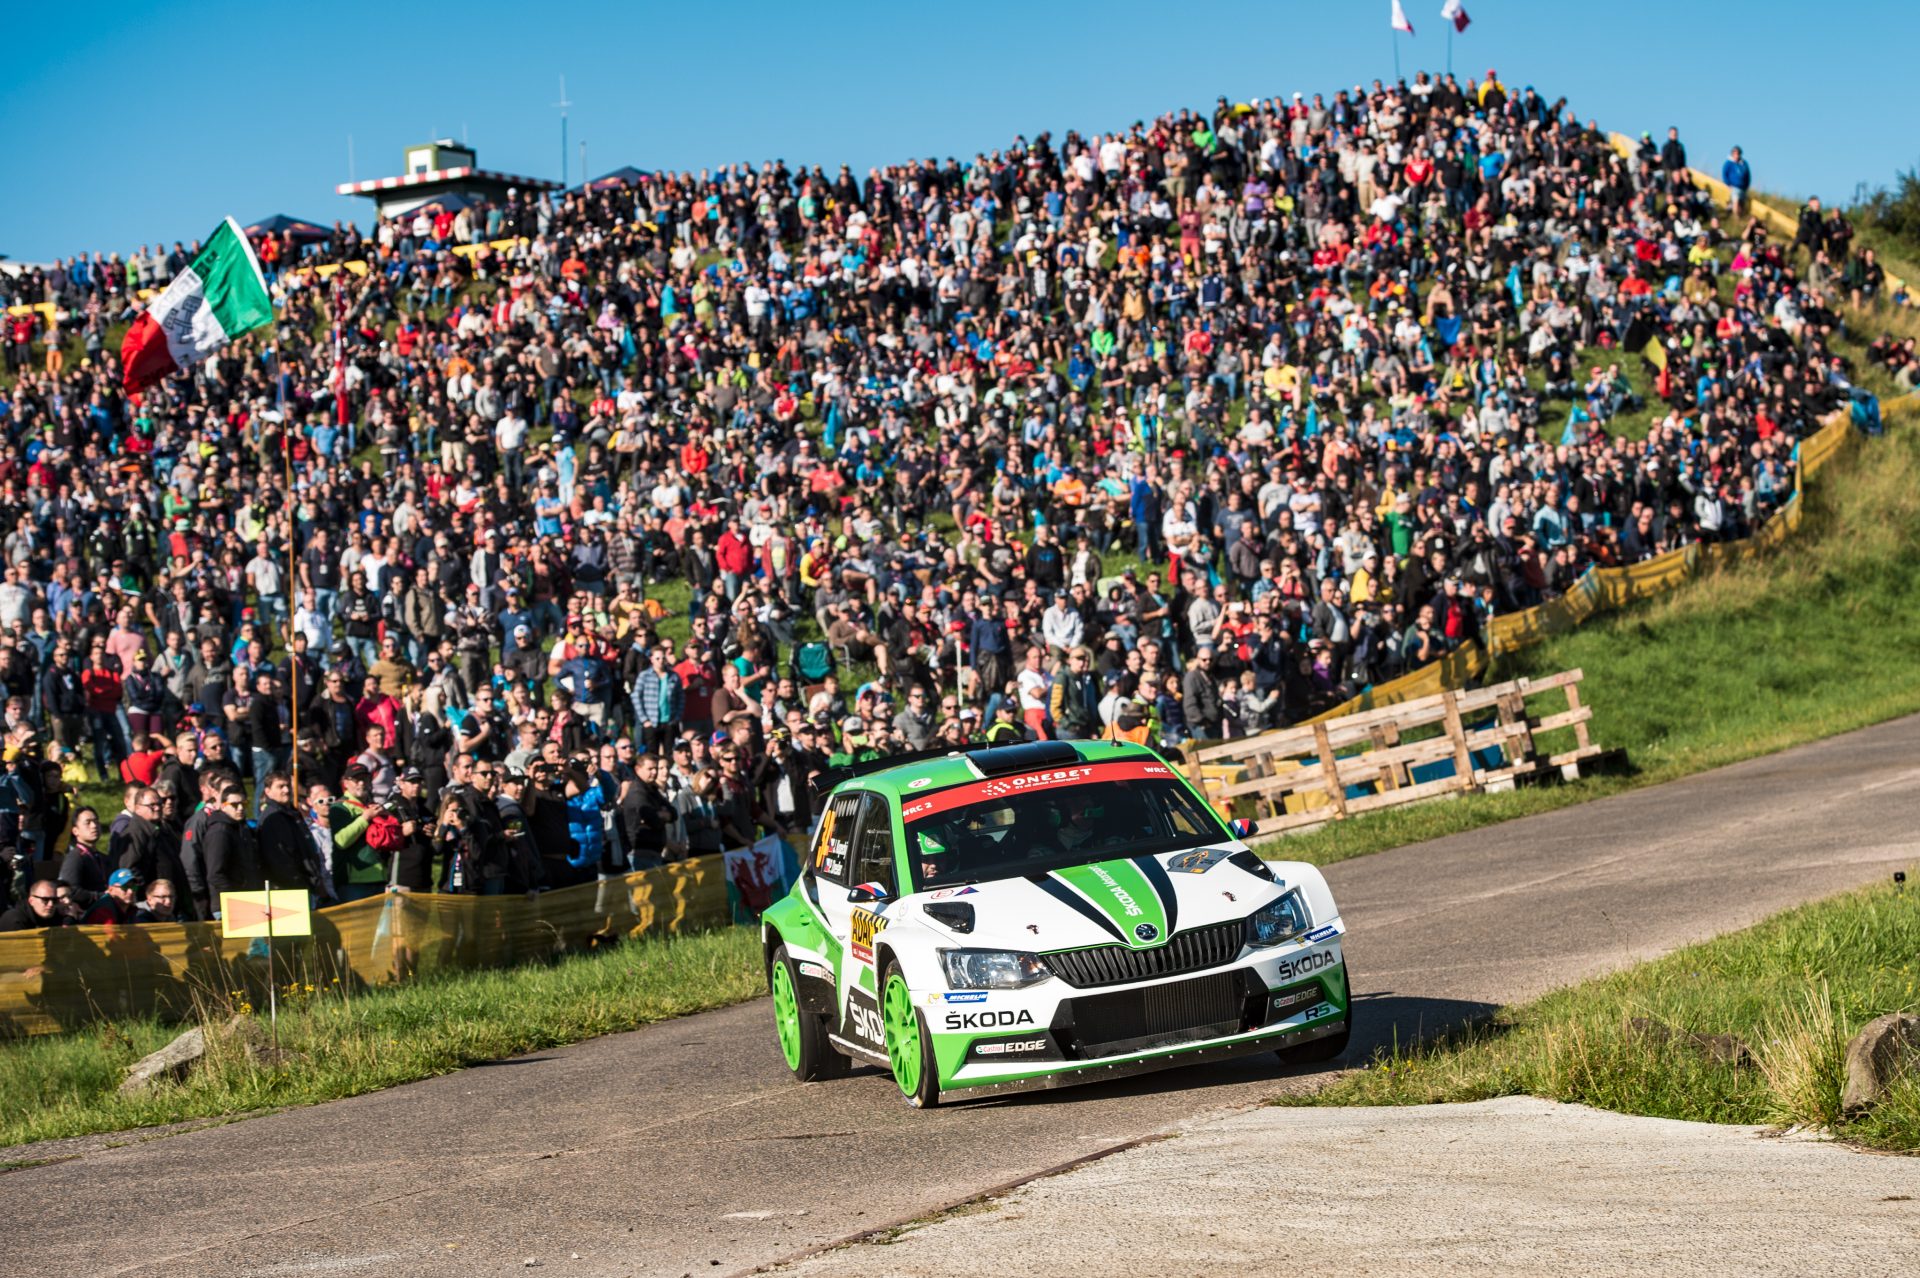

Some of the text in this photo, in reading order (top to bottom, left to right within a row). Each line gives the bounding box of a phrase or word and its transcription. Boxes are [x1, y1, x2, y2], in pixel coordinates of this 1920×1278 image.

[1012, 768, 1092, 785] ONEBET
[1310, 925, 1336, 941] MICHELIN
[1279, 949, 1336, 981] ŠKODA
[949, 993, 988, 1001] MICHELIN
[945, 1009, 1035, 1030] ŠKODA
[1305, 1003, 1331, 1021] R5
[1005, 1039, 1047, 1052] EDGE
